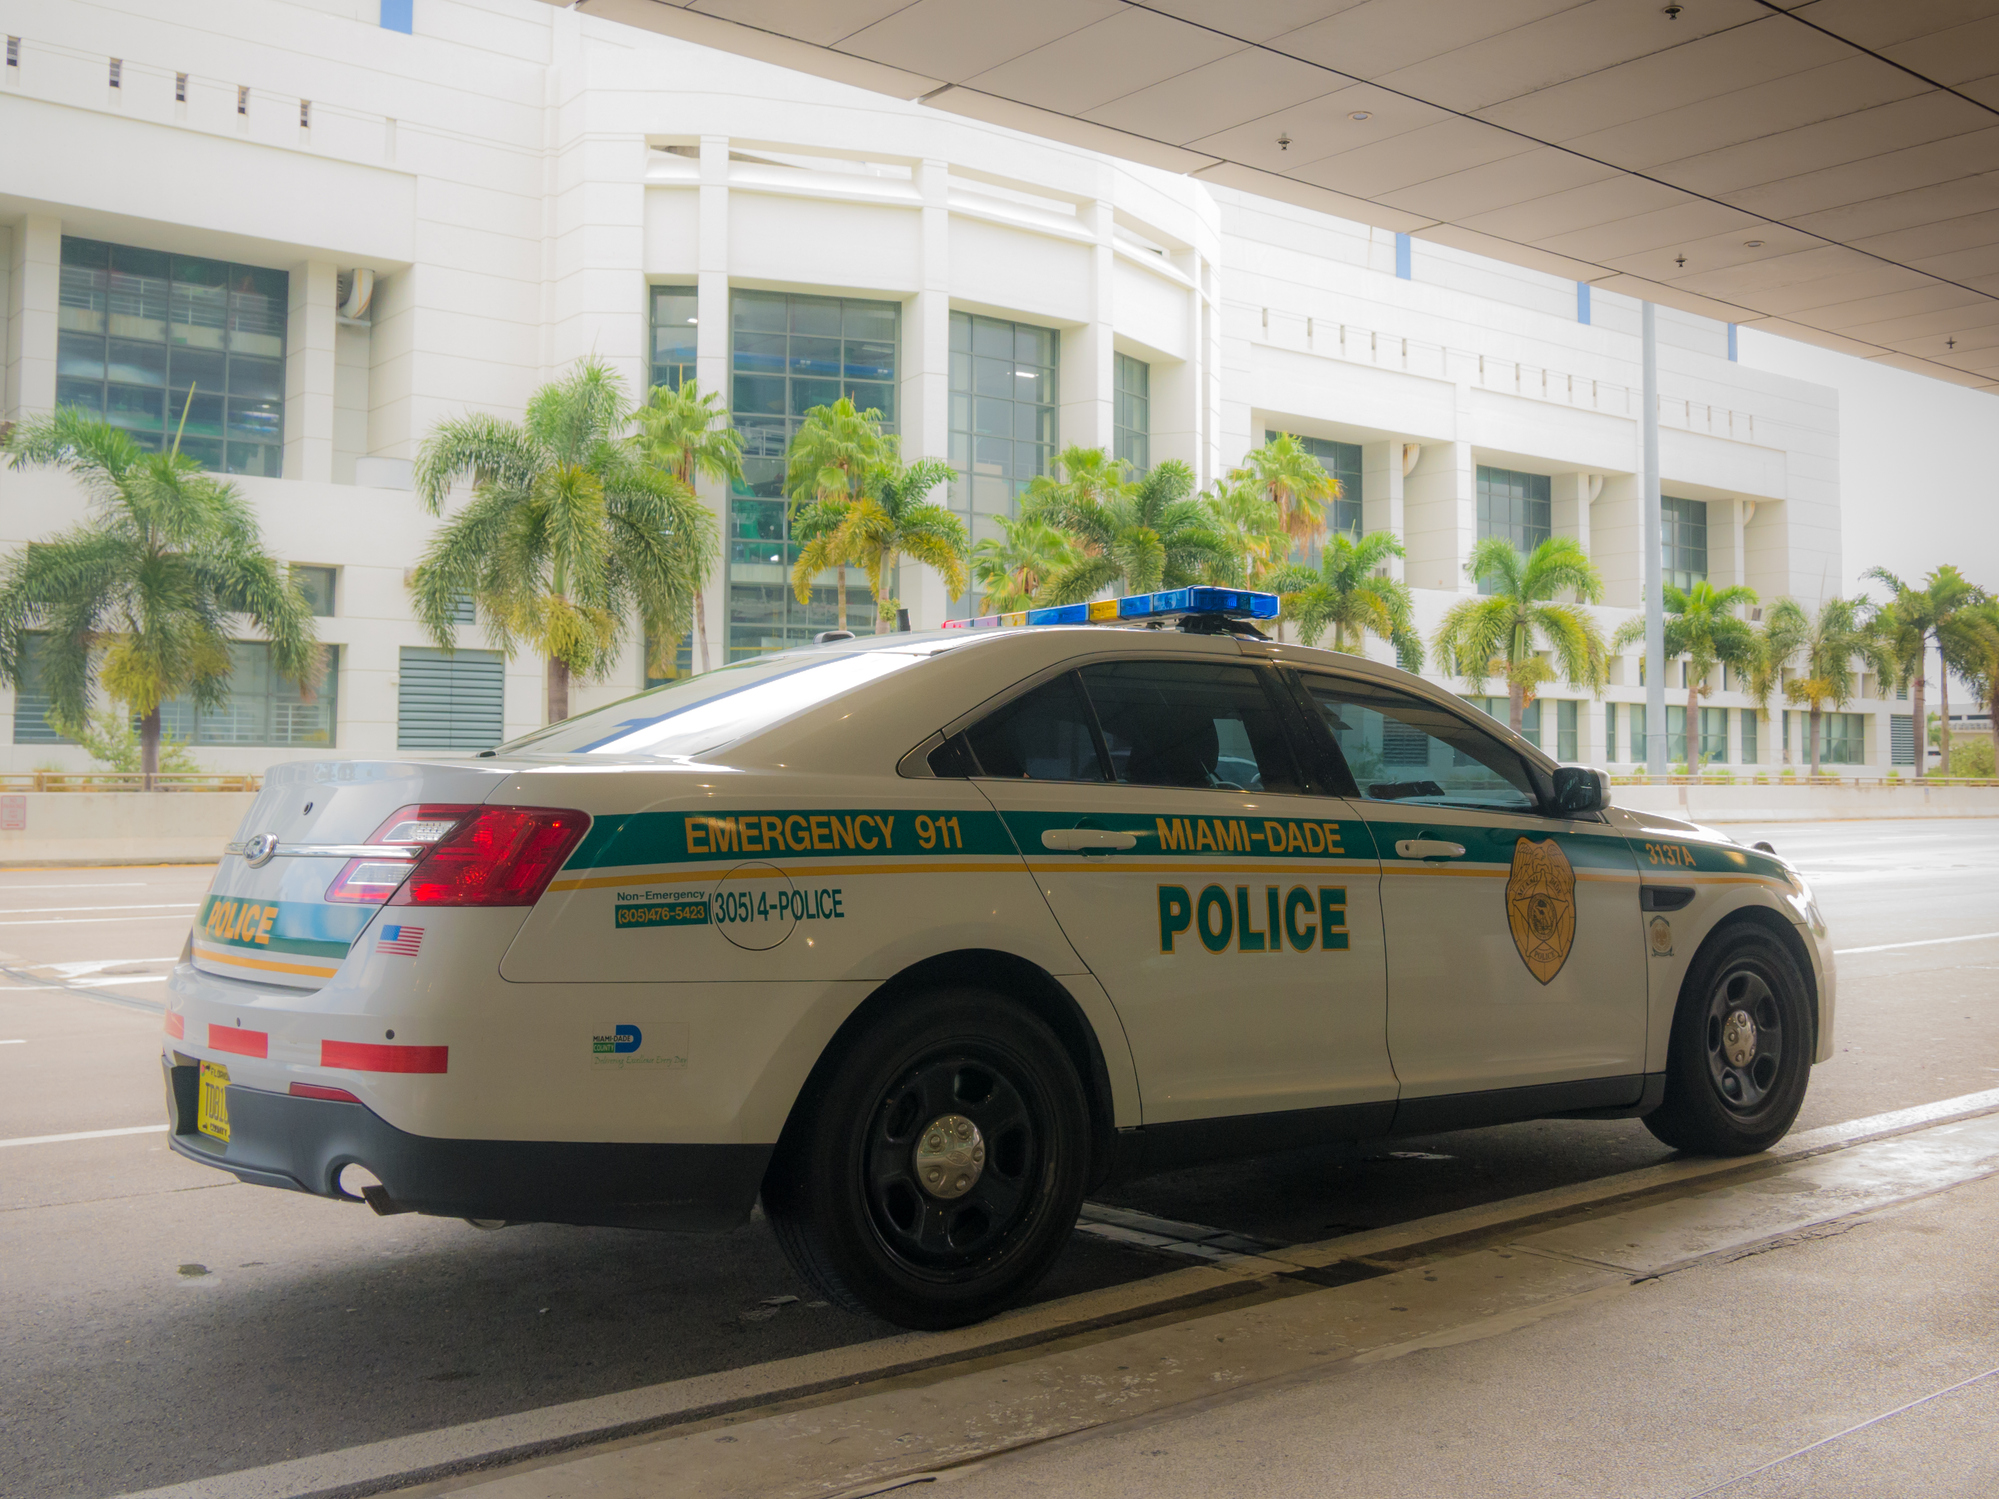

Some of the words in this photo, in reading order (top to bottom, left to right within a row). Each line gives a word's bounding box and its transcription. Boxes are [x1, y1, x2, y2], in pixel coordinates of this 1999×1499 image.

[684, 814, 895, 854] EMERGENCY
[914, 814, 963, 850] 911
[1155, 818, 1345, 854] MIAMI-DADE
[1645, 843, 1697, 867] 3137A
[617, 889, 706, 902] Non-Emergency
[205, 901, 279, 945] POLICE
[617, 905, 706, 925] (305)476-5423
[1157, 882, 1350, 955] POLICE
[1533, 950, 1556, 961] POLICE
[593, 1044, 614, 1052] COUNTY
